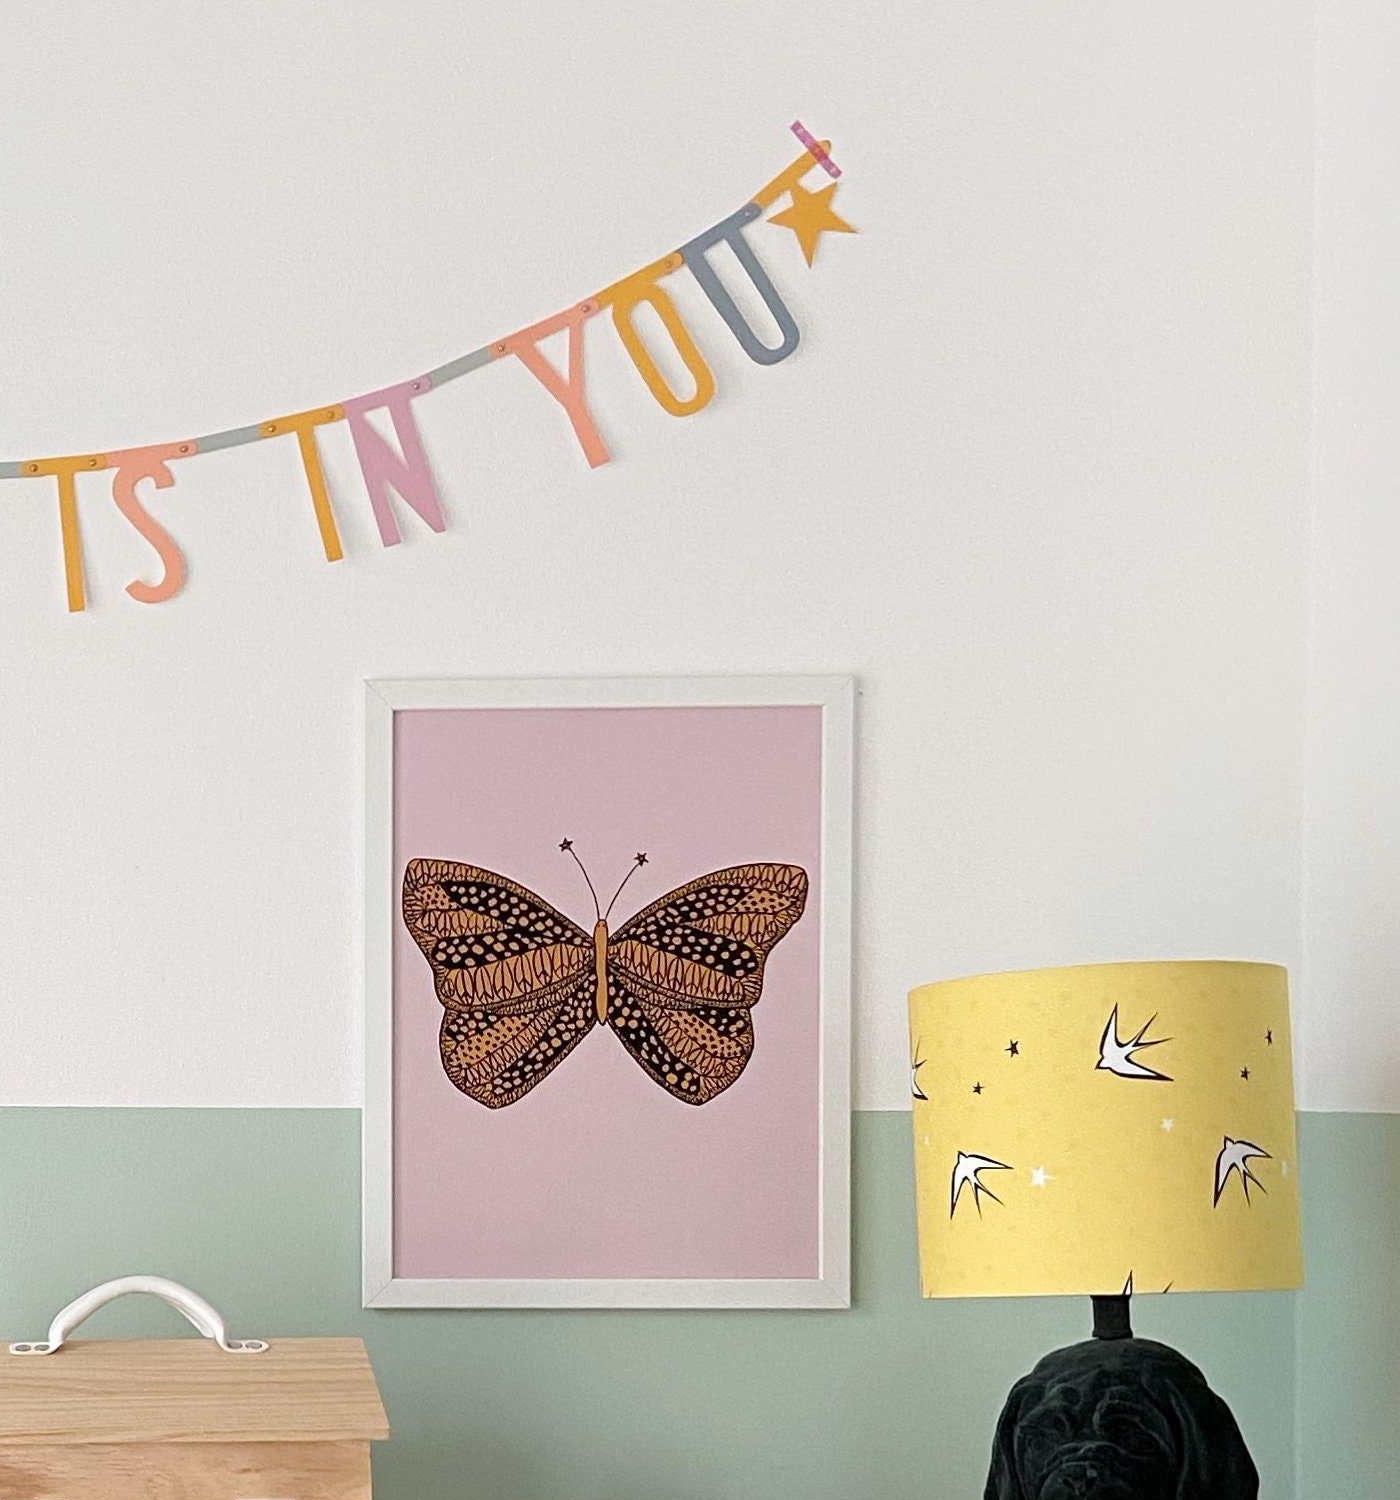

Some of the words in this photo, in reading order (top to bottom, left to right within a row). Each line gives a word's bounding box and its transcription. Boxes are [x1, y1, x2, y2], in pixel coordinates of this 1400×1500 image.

[21, 439, 198, 612] IS
[260, 374, 446, 562] IN
[488, 202, 800, 469] YOU
